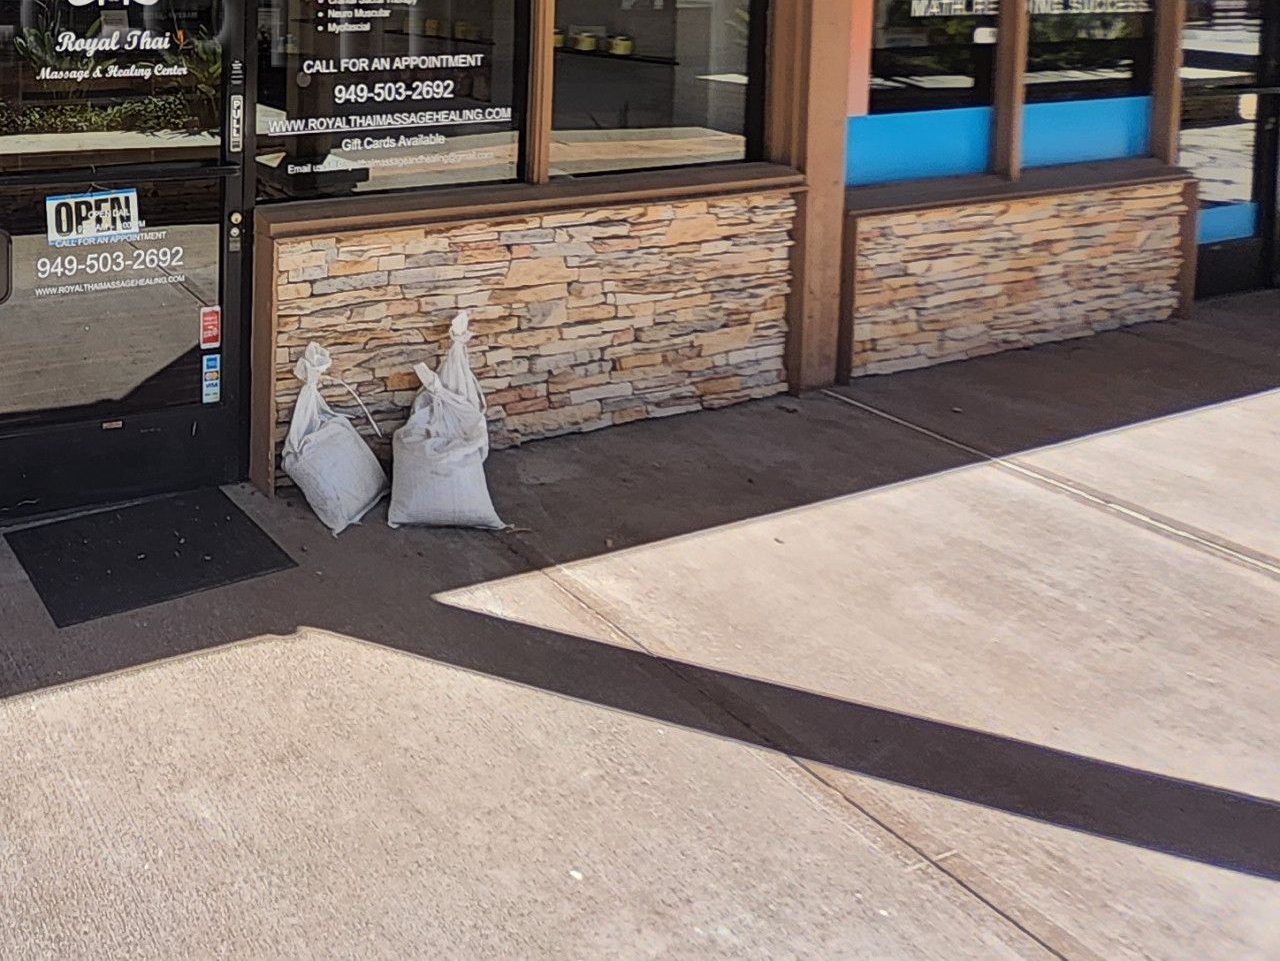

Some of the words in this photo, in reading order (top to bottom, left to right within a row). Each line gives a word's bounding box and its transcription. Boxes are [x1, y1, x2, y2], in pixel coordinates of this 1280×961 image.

[55, 30, 120, 57] Royal
[124, 30, 170, 50] Thai
[36, 67, 90, 82] Massage
[92, 66, 103, 78] &
[105, 65, 153, 81] Healing
[153, 64, 188, 77] Center
[303, 59, 338, 74] CALL
[340, 57, 369, 72] FOR
[370, 57, 391, 71] AN
[393, 54, 484, 70] APPOINTMENT
[334, 80, 455, 104] 949-503-2692
[232, 100, 241, 137] PULL
[268, 107, 512, 134] WWW.ROYALTHAIMASSAGEHEALING.COM
[341, 138, 363, 152] Gift
[363, 135, 396, 150] Cards
[397, 133, 446, 148] Available
[287, 163, 311, 174] Email
[55, 196, 131, 236] OPEN
[37, 246, 184, 279] 949-503-2692
